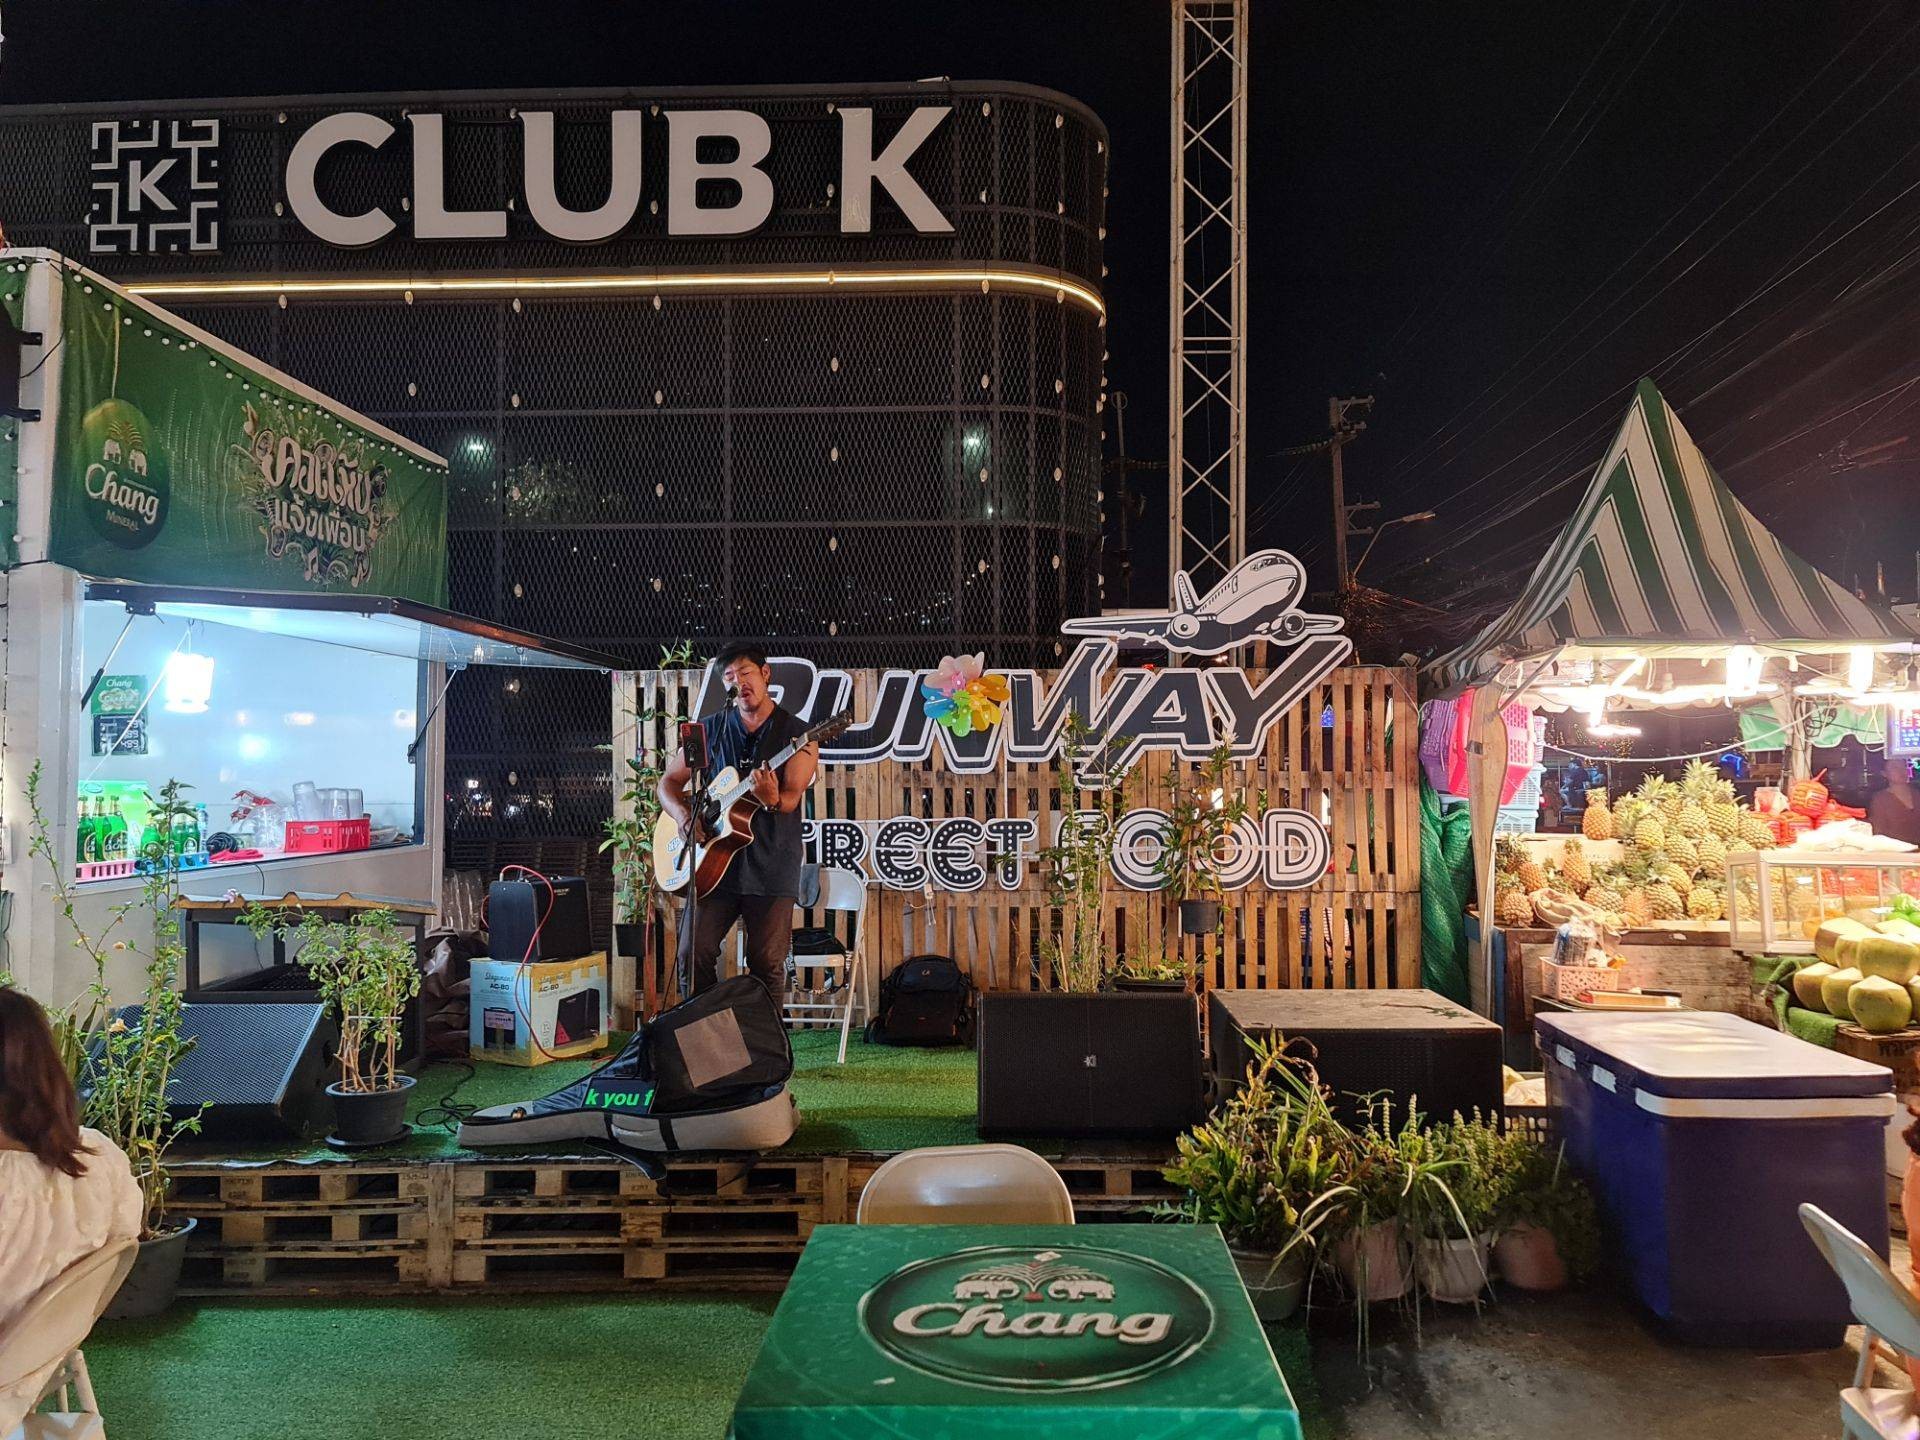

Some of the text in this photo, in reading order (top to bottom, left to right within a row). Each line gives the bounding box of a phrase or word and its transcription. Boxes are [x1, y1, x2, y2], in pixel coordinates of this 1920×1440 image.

[128, 158, 178, 211] K
[285, 106, 955, 246] CLUB K
[85, 463, 160, 525] Chang
[105, 679, 133, 690] Chang
[801, 815, 1036, 893] REET
[585, 1088, 600, 1105] k
[601, 1092, 640, 1109] you
[892, 1301, 1174, 1344] Chang
